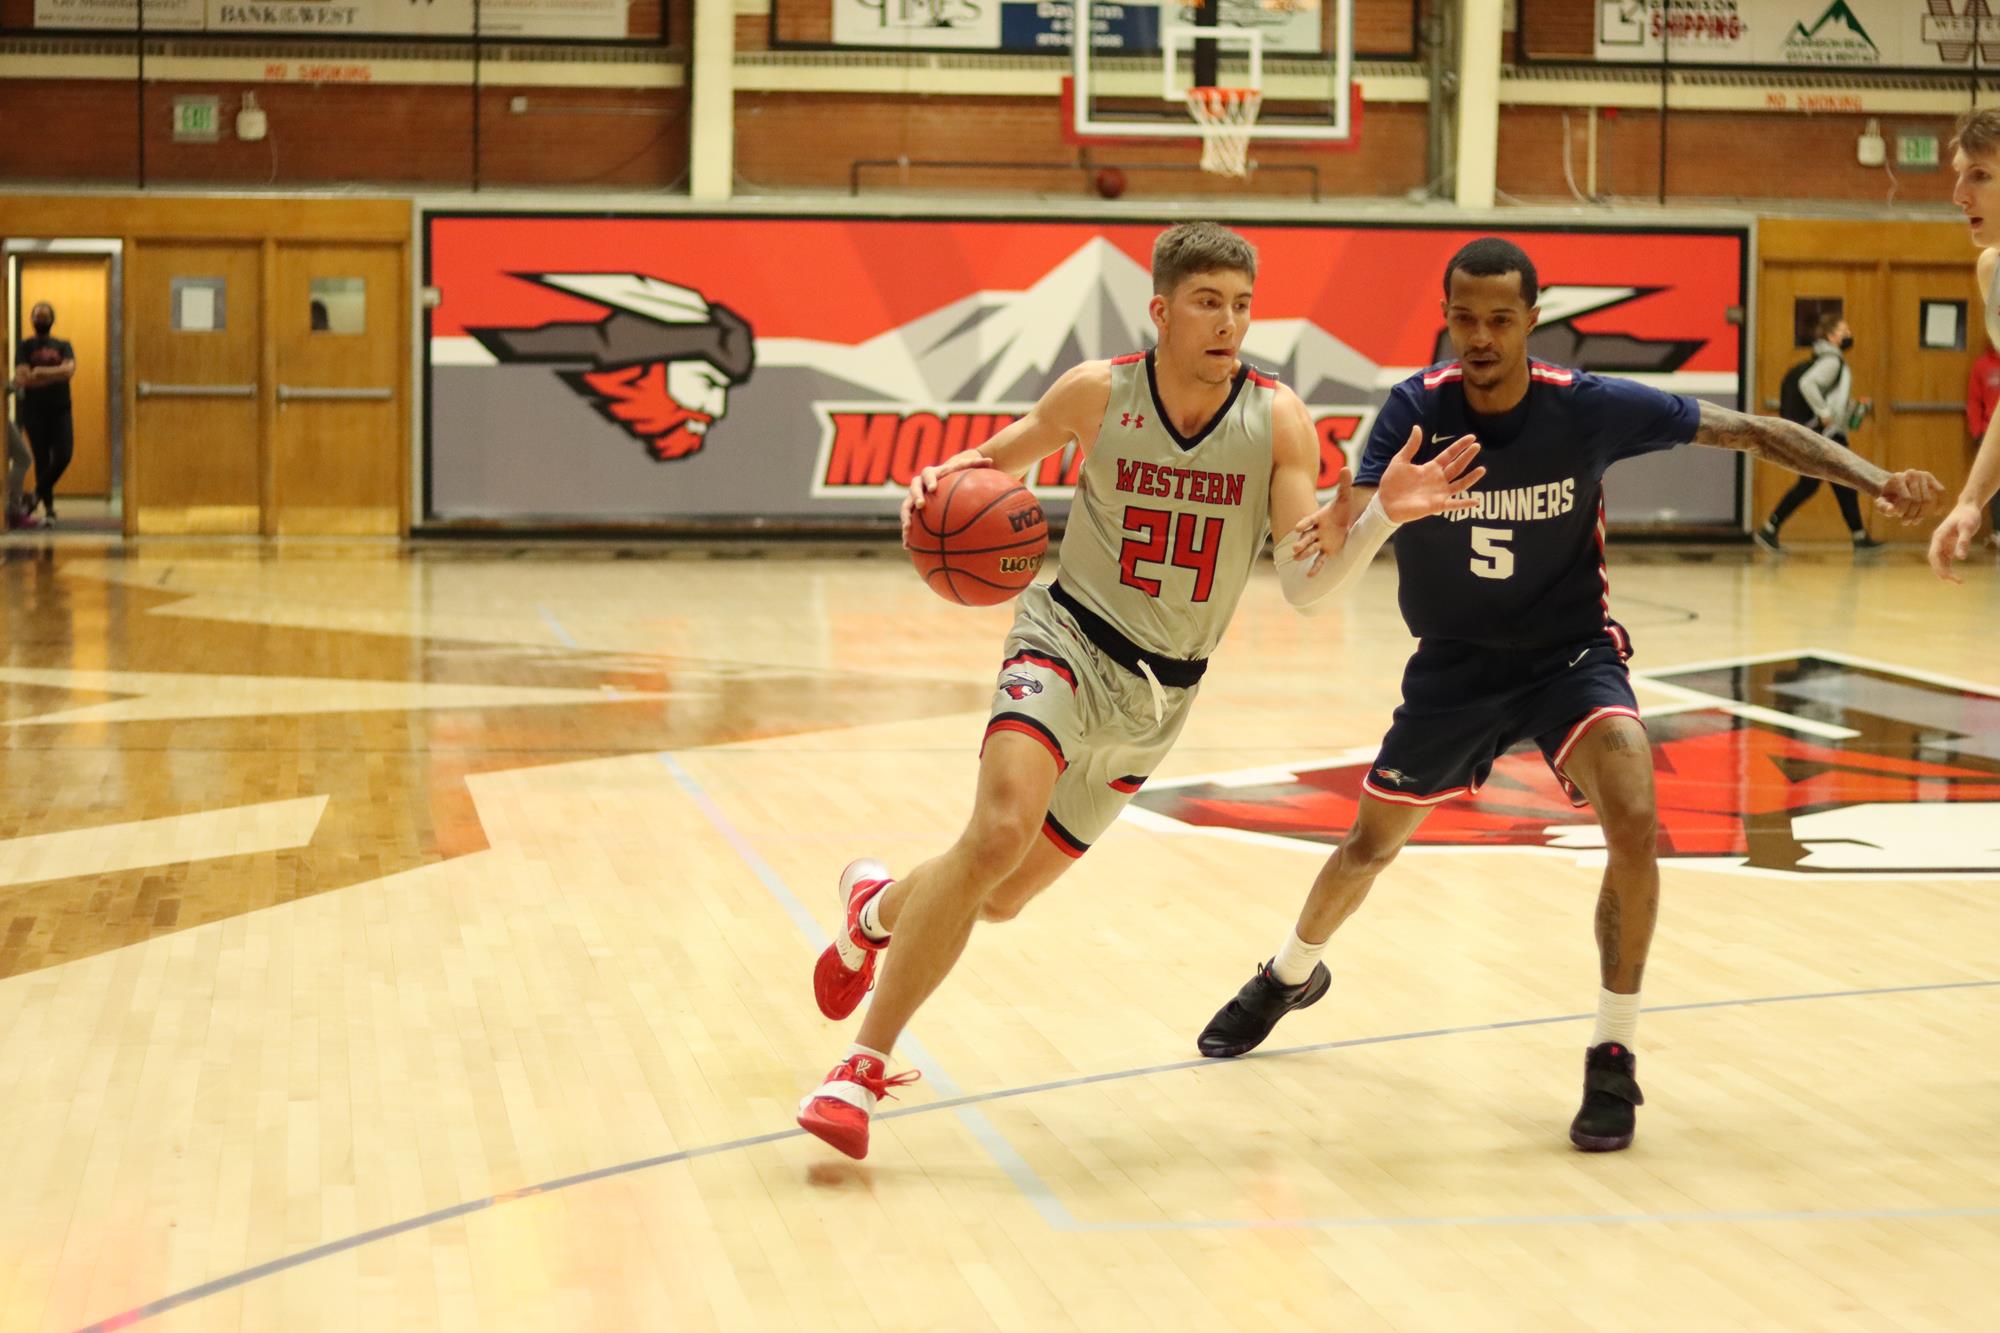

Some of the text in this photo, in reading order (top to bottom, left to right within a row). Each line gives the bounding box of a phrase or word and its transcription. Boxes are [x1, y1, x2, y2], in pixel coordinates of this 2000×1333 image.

[219, 6, 277, 24] BANK
[1650, 11, 1741, 39] SHIPPING
[265, 63, 372, 82] NO SMOKING
[1766, 92, 1863, 112] NO SMOKING
[182, 104, 212, 131] EXIT
[1116, 458, 1246, 506] WESTERN
[1118, 504, 1225, 603] 24
[1469, 525, 1515, 580] 5
